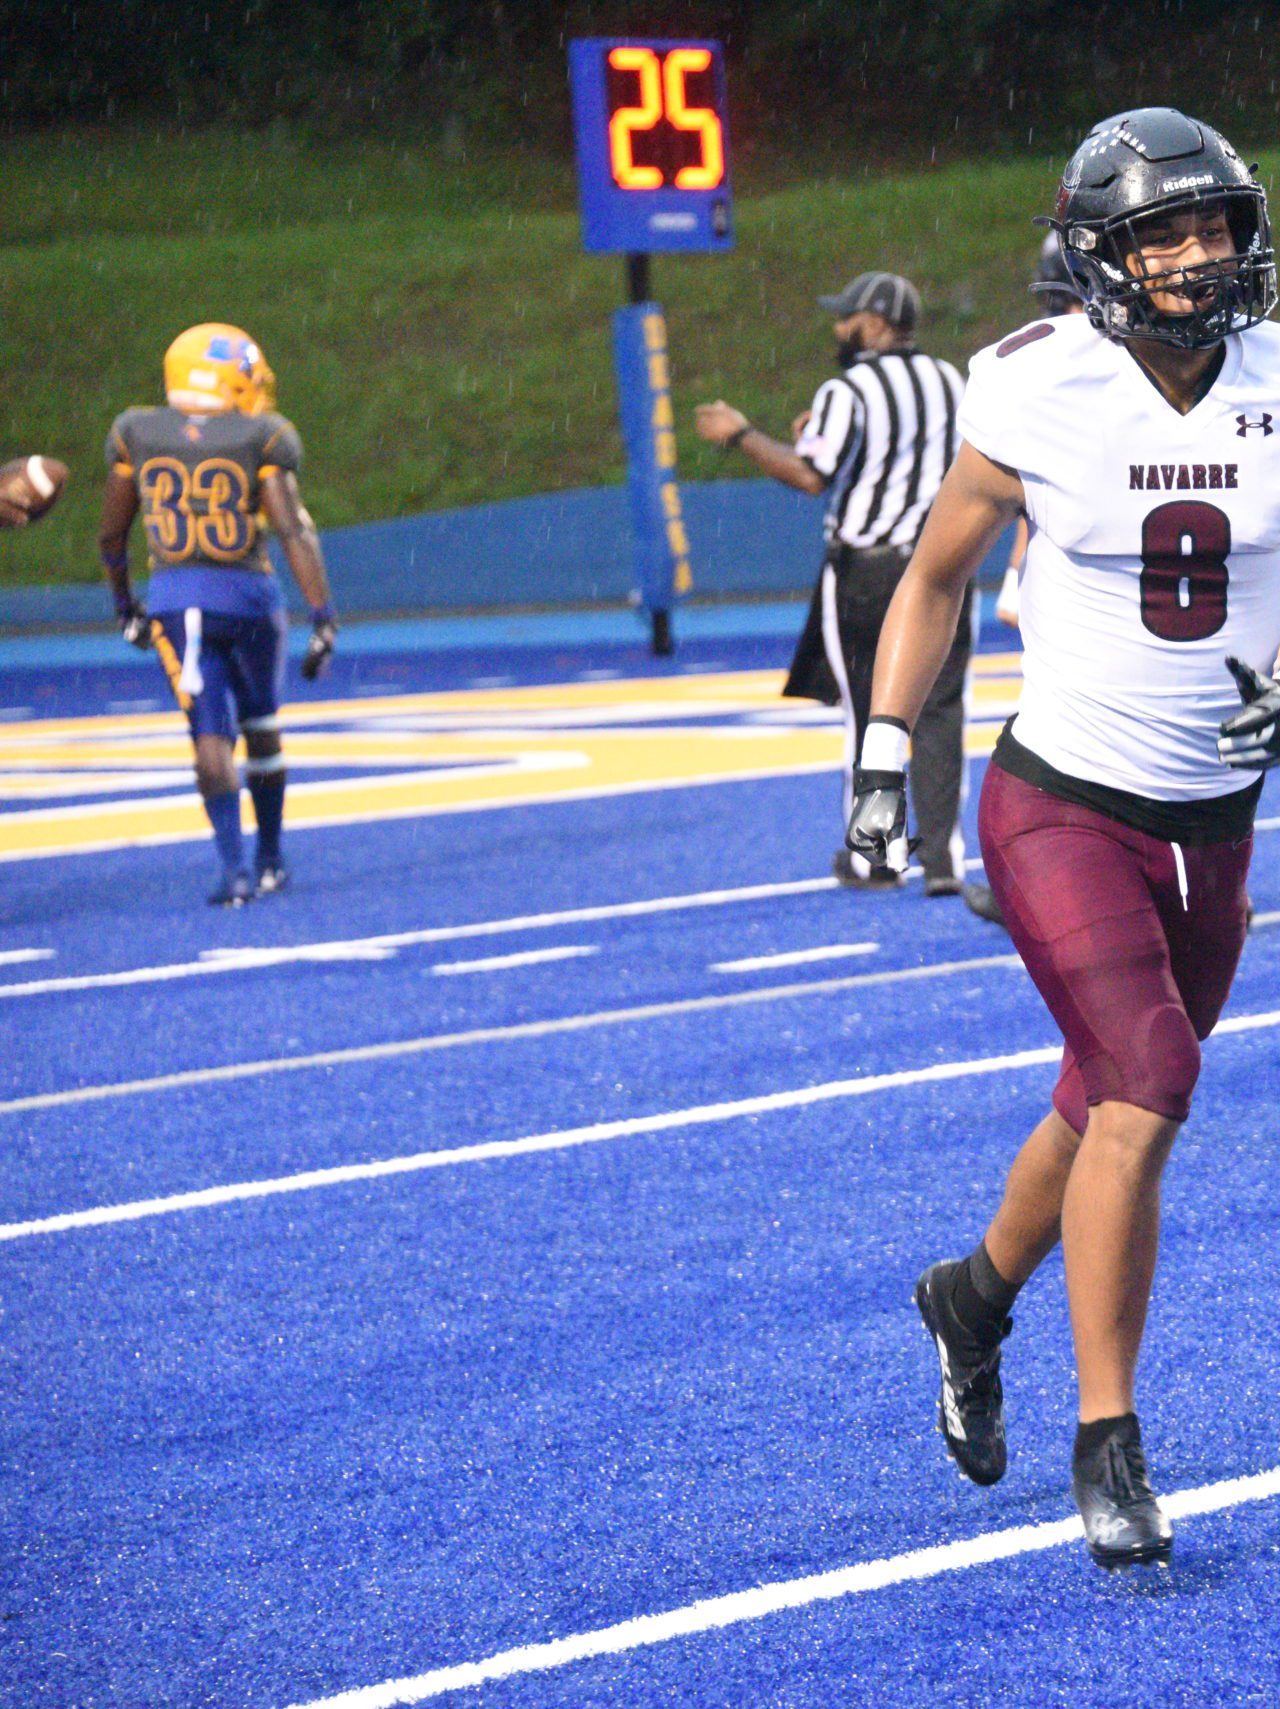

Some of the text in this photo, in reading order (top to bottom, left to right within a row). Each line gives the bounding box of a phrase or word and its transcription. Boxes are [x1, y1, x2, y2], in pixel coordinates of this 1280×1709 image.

[608, 48, 724, 190] 25
[1163, 174, 1214, 193] Riddell
[139, 456, 256, 562] 33
[1129, 464, 1239, 490] NAVARRE
[1139, 499, 1232, 642] 8
